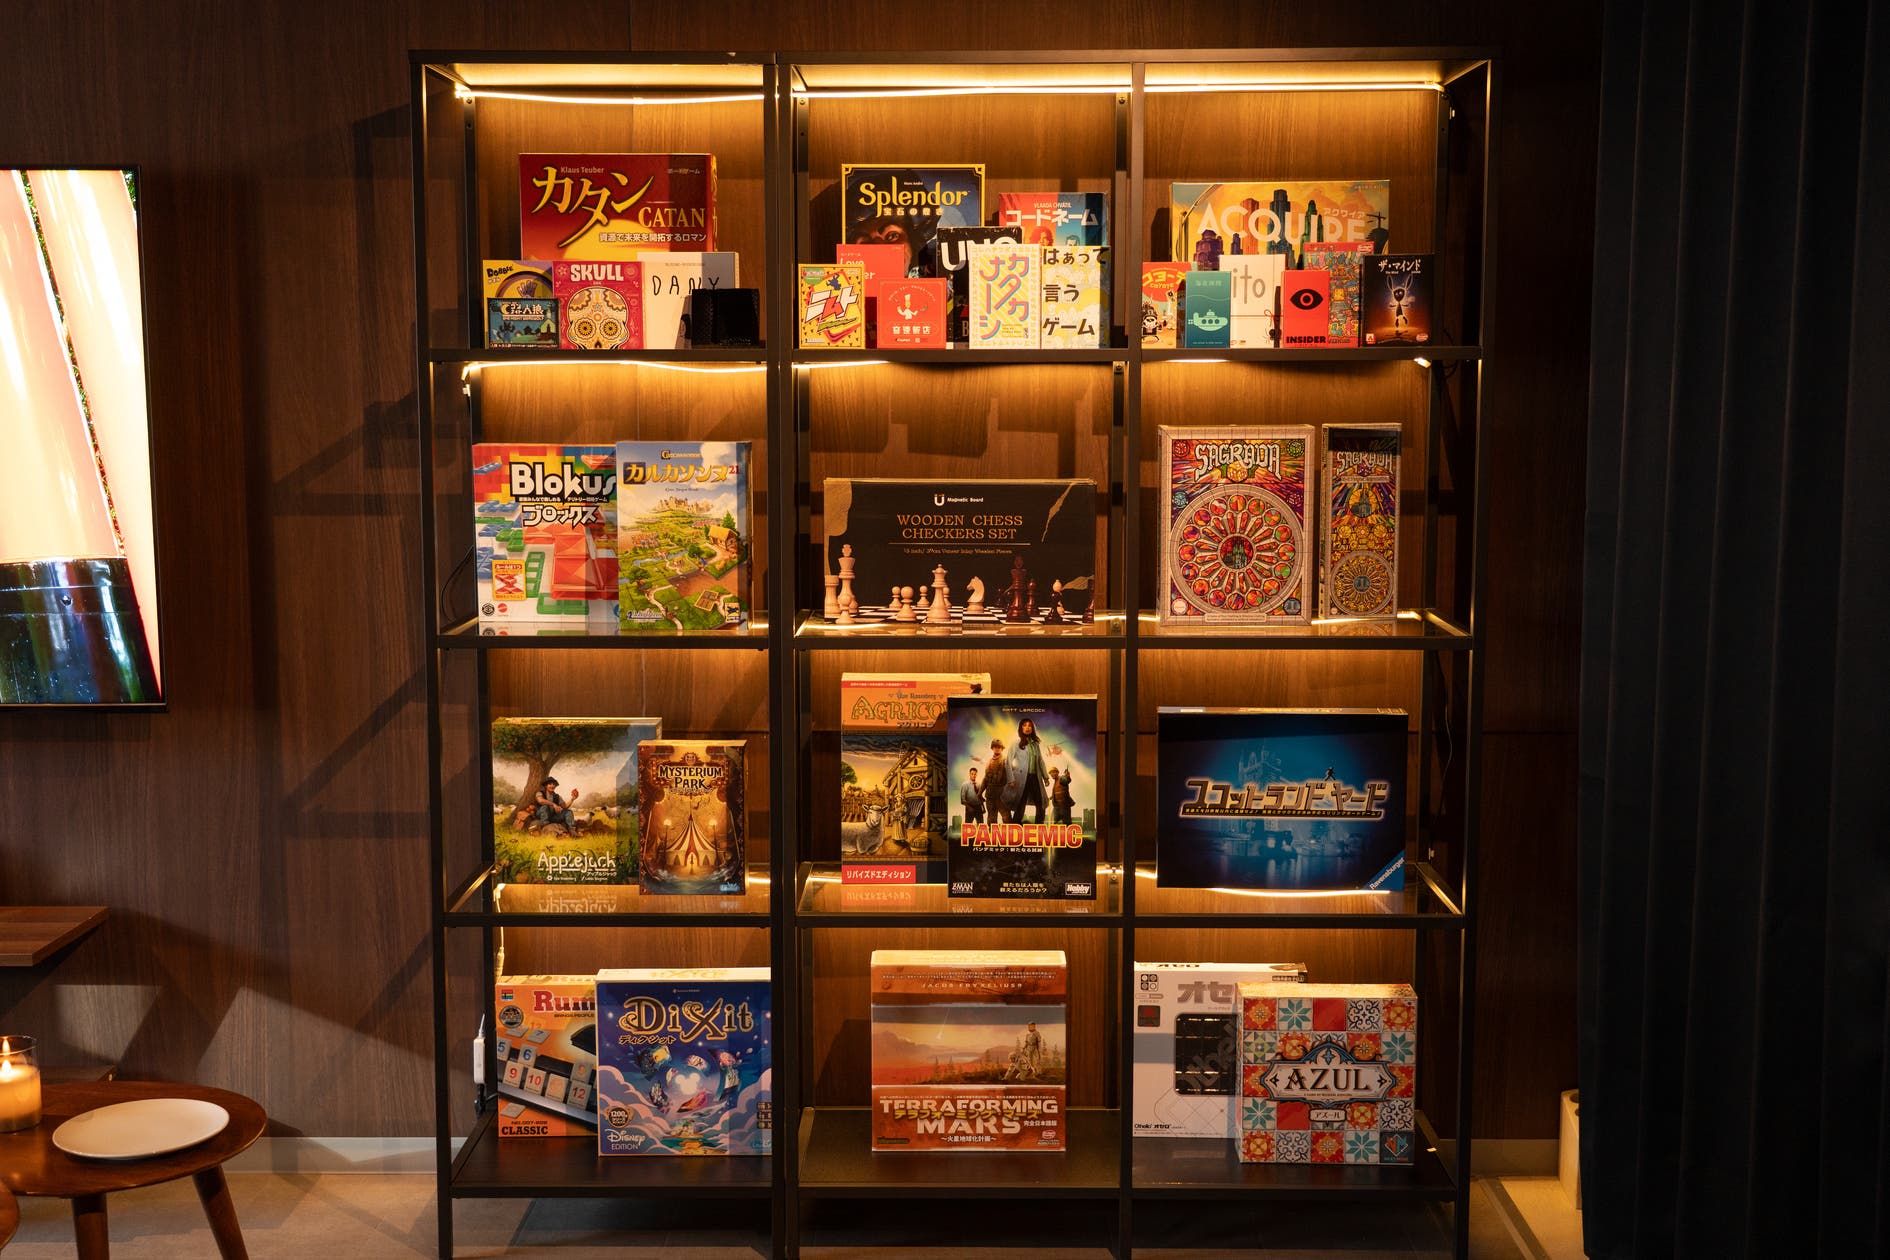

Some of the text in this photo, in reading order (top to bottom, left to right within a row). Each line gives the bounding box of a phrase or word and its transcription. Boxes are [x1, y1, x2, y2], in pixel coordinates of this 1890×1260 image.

[859, 176, 968, 218] Splendor
[531, 166, 654, 248] カタン
[638, 206, 705, 228] CATAN
[1005, 209, 1099, 226] コードネーム
[1197, 202, 1367, 245] ACQUIRE
[570, 264, 624, 282] SKULL
[1378, 259, 1421, 272] ザ・マインド
[1232, 264, 1266, 304] ito
[1043, 284, 1080, 303] 言う
[1042, 317, 1095, 336] ゲーム
[729, 465, 738, 474] 21
[1194, 443, 1282, 482] SAGRADA
[522, 505, 599, 527] ブロックス
[897, 515, 1023, 526] WOODEN CHESS
[902, 528, 1017, 539] CHECKERS SET
[658, 765, 722, 779] MYSTERIUM
[674, 777, 711, 790] PARK
[1183, 779, 1387, 810] スコットランドヤード
[960, 823, 1083, 848] PANDEMIC
[538, 851, 616, 874] Applejack
[1370, 857, 1404, 890] Ravensburger
[523, 1049, 532, 1060] 6
[509, 1067, 518, 1079] 9
[528, 1074, 542, 1086] 10
[1284, 1069, 1370, 1090] AZUL
[572, 1087, 586, 1100] 12
[880, 1100, 1058, 1113] TERRAFORMING
[1314, 1111, 1340, 1119] アズール
[501, 1126, 548, 1135] CLASSIC
[917, 1115, 1021, 1134] MARS
[604, 1129, 646, 1146] Disney
